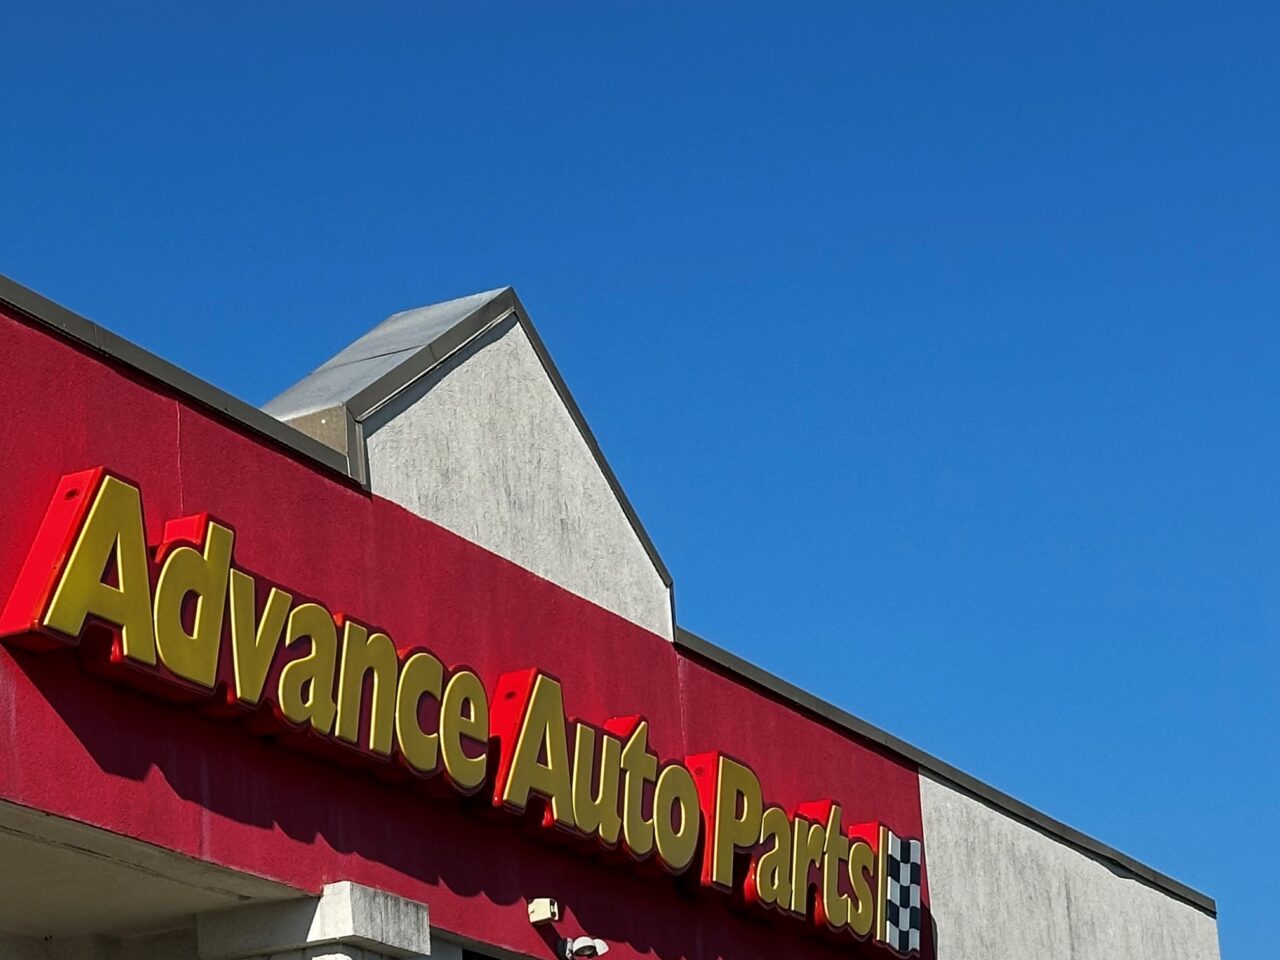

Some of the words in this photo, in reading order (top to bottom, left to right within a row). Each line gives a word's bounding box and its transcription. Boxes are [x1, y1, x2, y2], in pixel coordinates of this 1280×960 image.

[40, 474, 490, 797] Advance
[501, 673, 700, 874] Auto
[714, 754, 876, 932] Parts
